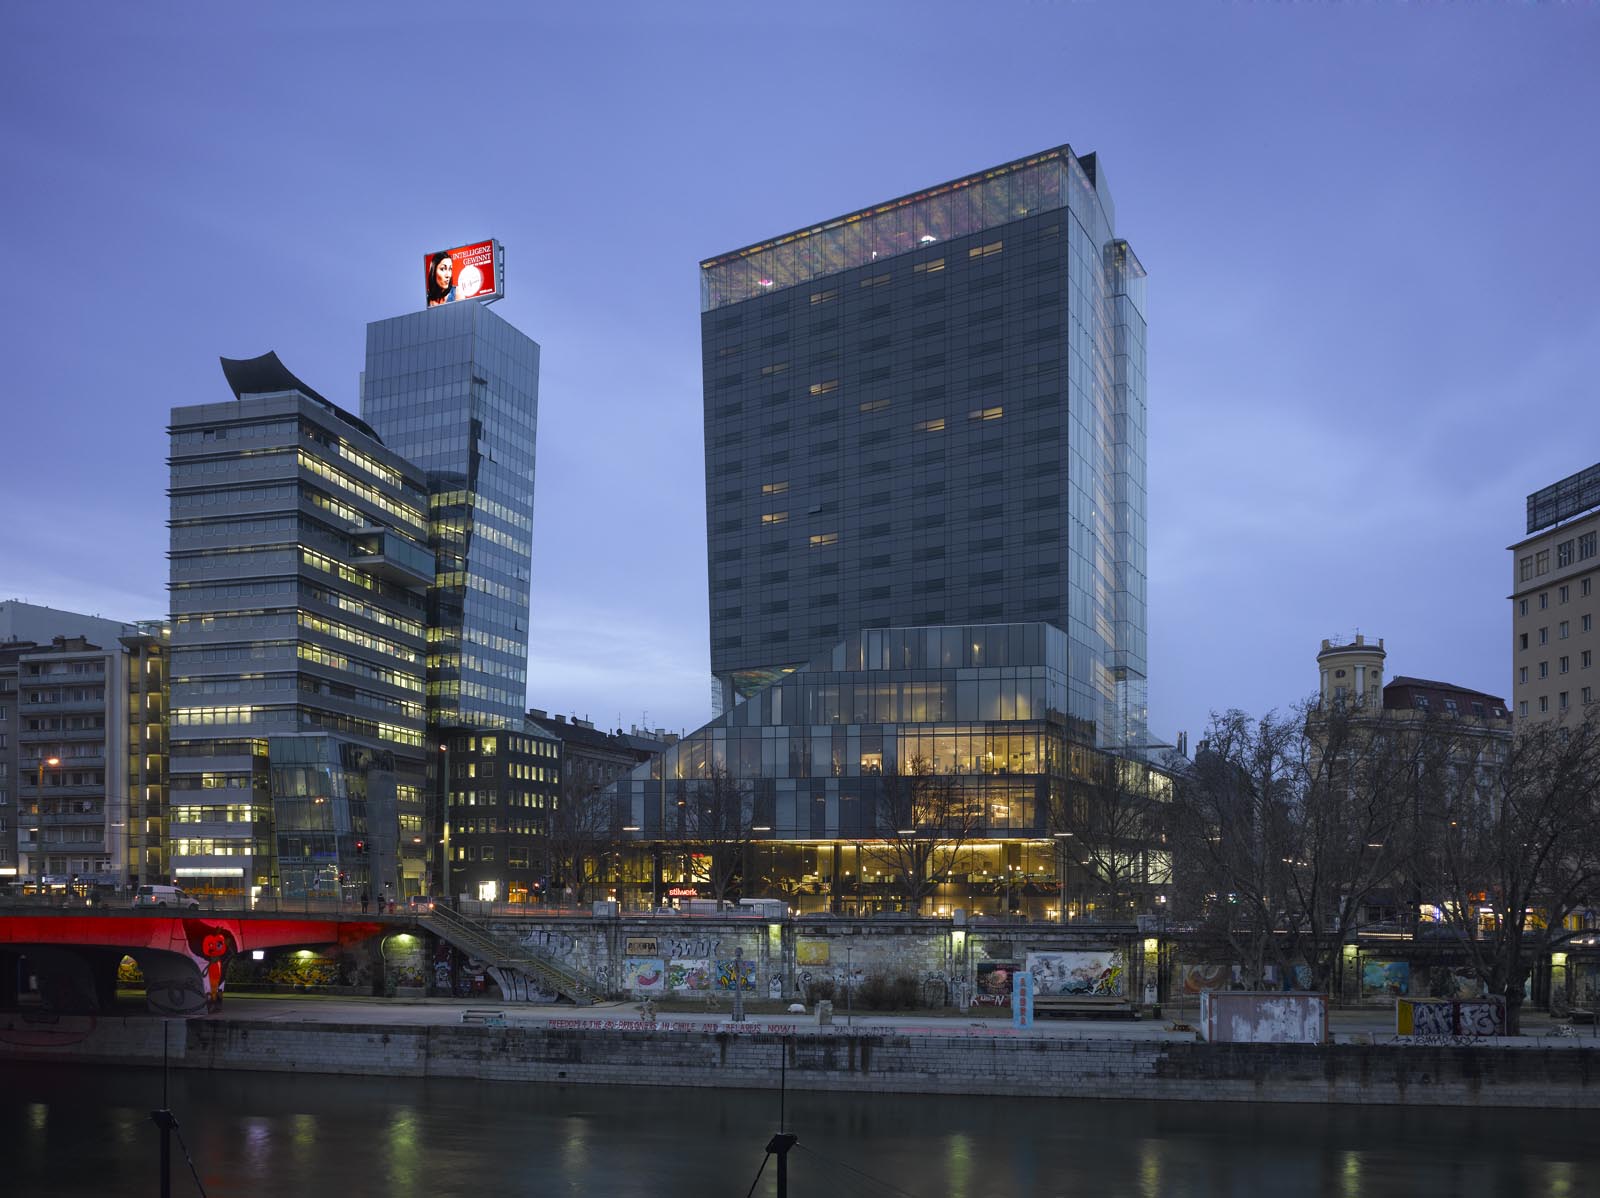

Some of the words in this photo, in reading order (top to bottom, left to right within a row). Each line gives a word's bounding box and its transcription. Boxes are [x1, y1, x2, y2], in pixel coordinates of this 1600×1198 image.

[452, 245, 491, 260] INTELLIGENZ
[463, 253, 491, 266] GEWINNT
[669, 888, 698, 896] stilwerk
[548, 1020, 579, 1028] FREEDOM
[590, 1020, 602, 1029] THE
[672, 1022, 696, 1031] CHILE
[702, 1023, 718, 1031] AND
[725, 1023, 760, 1032] BELARUS
